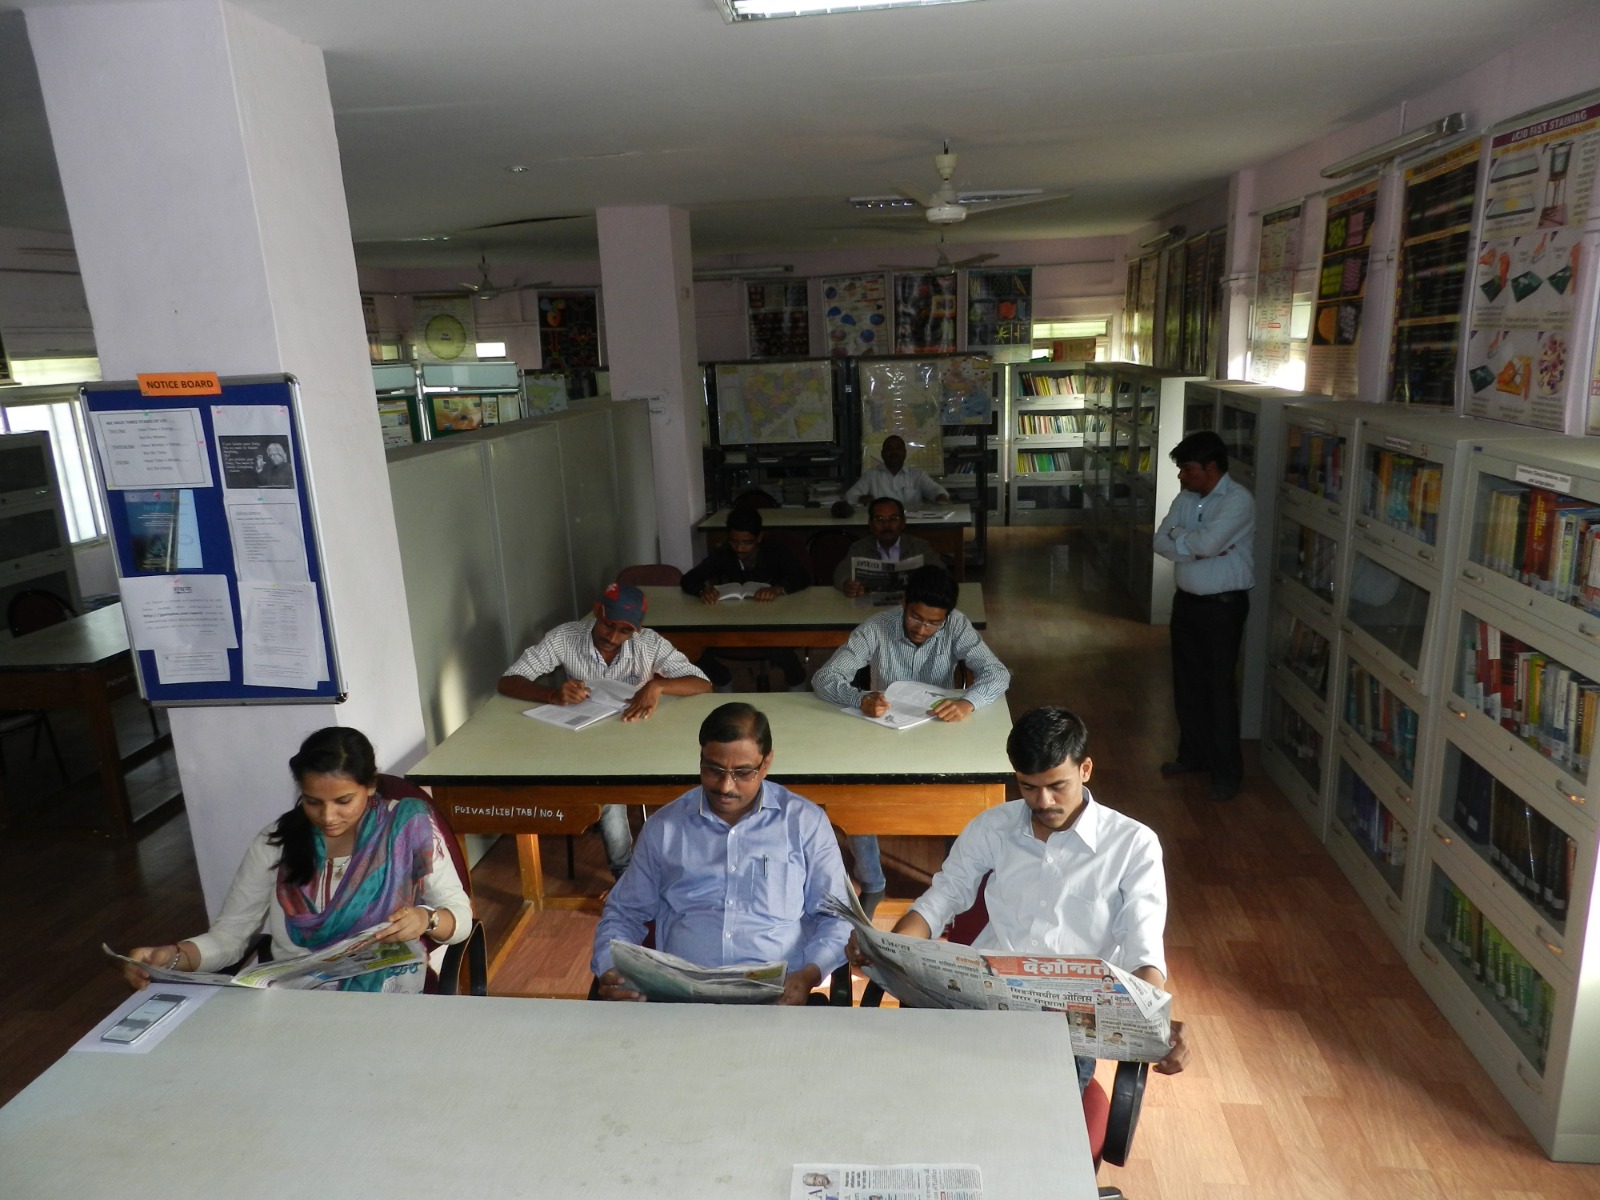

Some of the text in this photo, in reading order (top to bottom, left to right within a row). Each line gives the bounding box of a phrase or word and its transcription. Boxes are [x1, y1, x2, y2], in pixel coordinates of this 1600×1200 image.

[146, 380, 214, 389] NOTICE BOARD
[1062, 991, 1093, 1003] ओलिस
